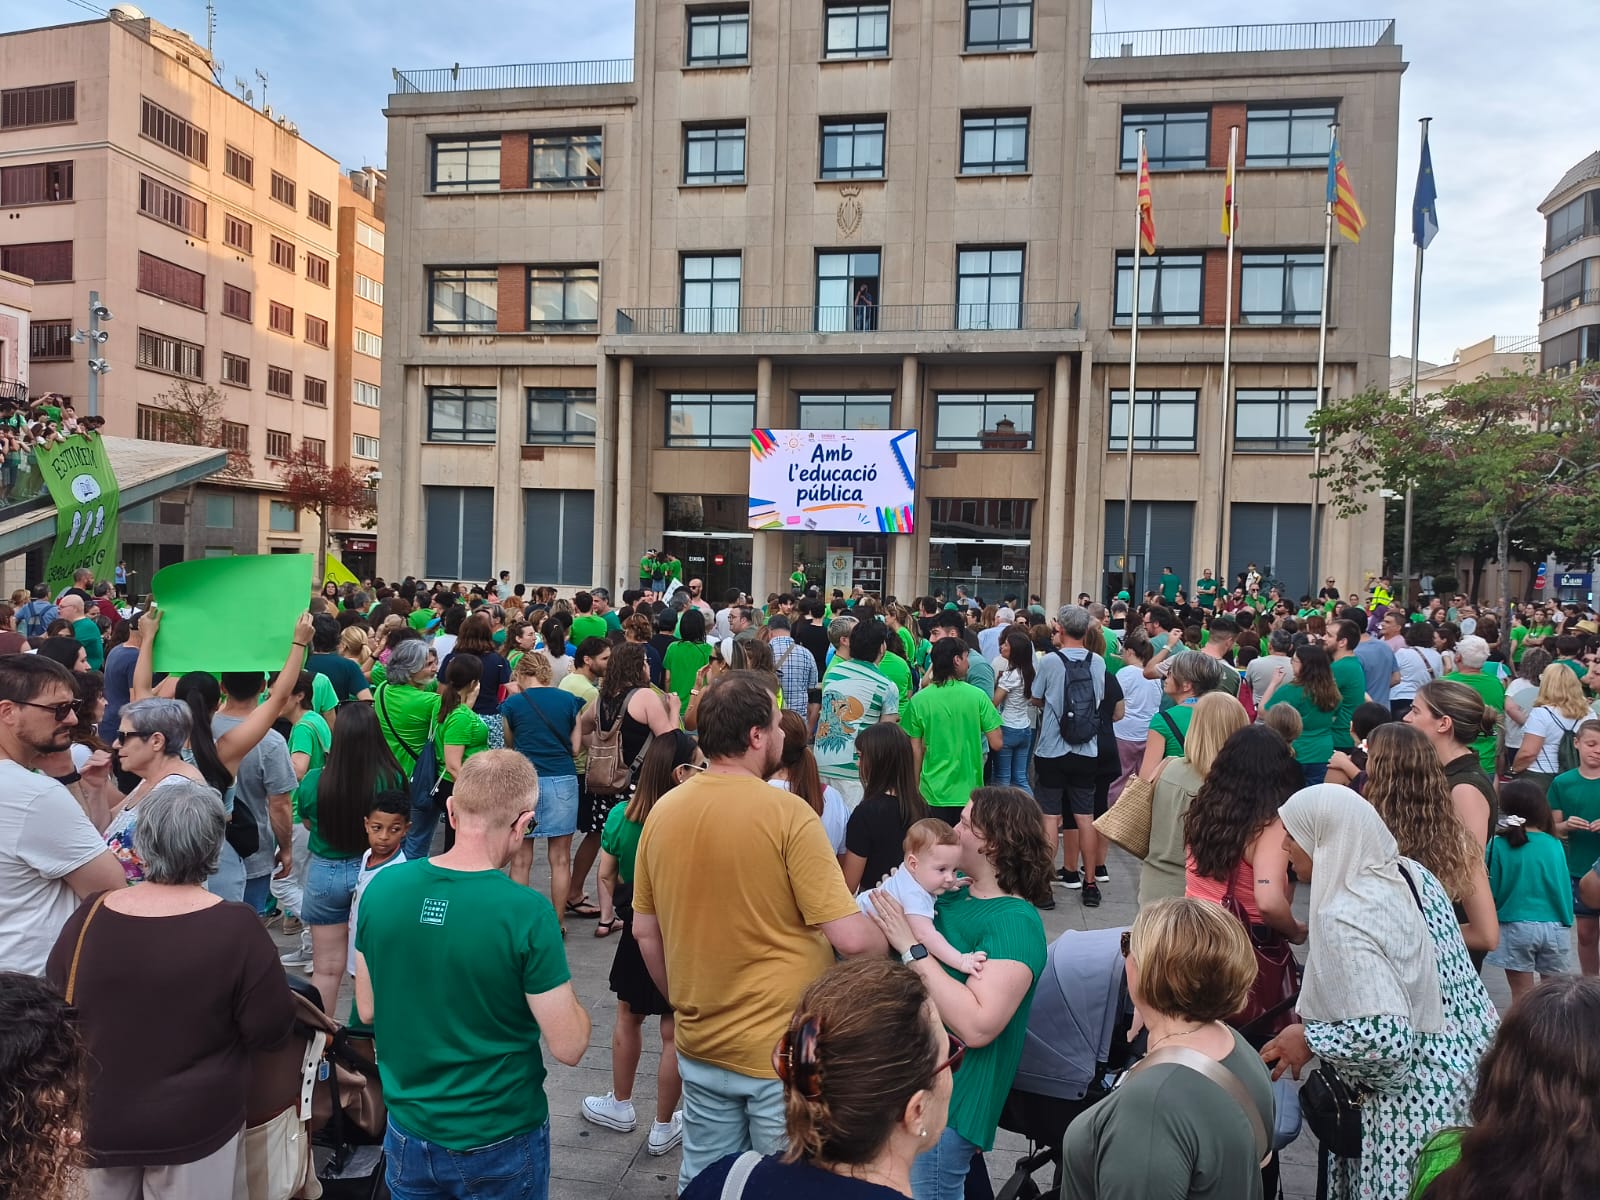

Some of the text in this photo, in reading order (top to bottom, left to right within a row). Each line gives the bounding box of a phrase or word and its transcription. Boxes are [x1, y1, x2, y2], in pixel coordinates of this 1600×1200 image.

[811, 443, 853, 463] Amb
[788, 463, 877, 482] l'educació
[796, 483, 863, 507] pública
